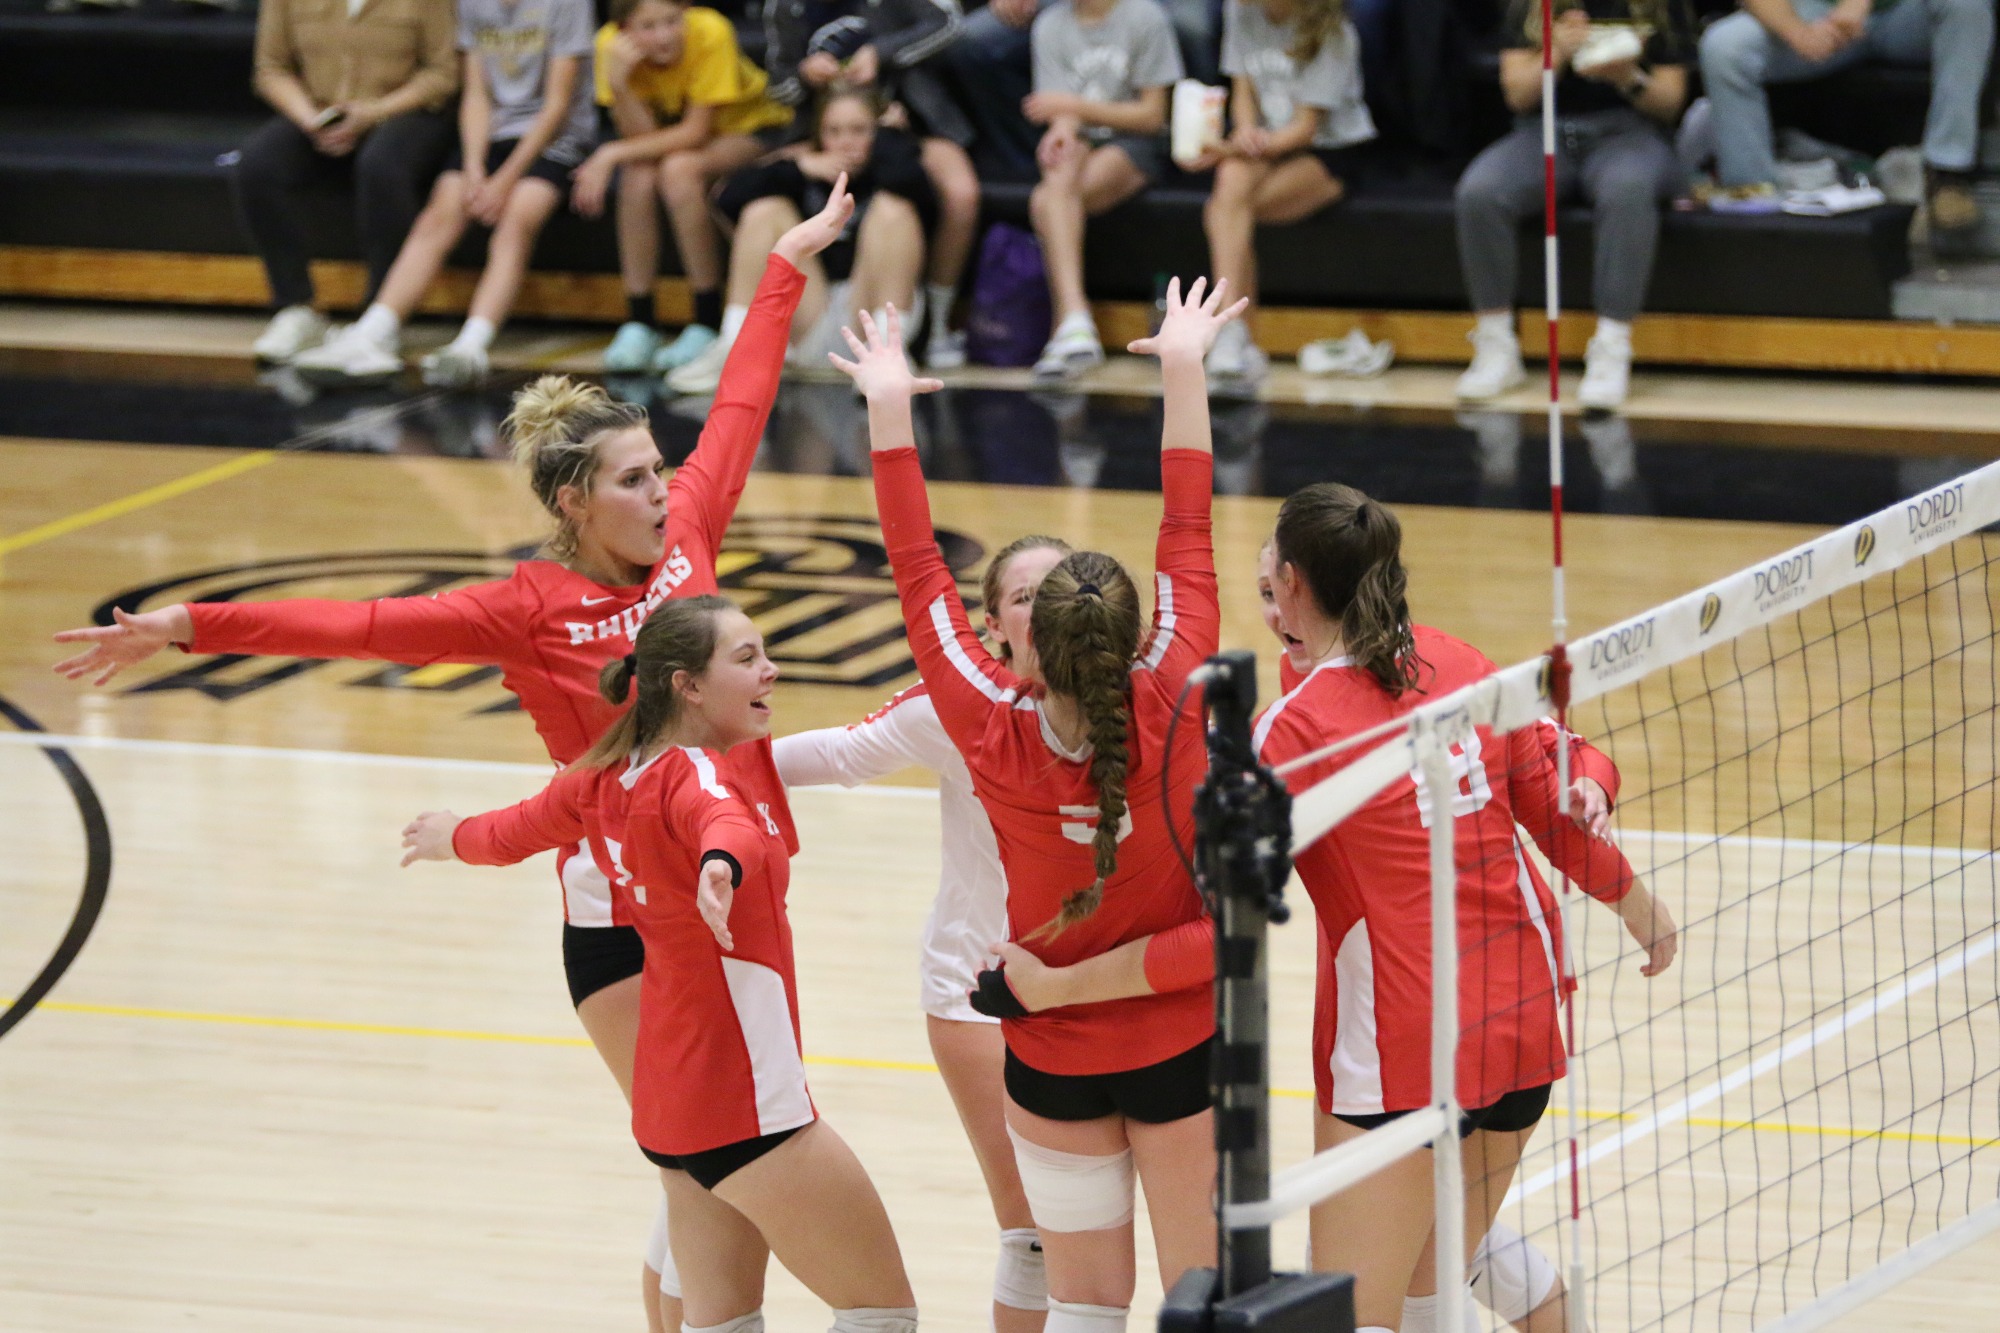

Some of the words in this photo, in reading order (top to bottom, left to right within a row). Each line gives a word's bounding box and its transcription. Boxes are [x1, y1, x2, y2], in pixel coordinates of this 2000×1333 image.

[1906, 482, 1964, 534] DORDT
[1753, 548, 1815, 601] DORDT
[1589, 616, 1656, 670] DORDT
